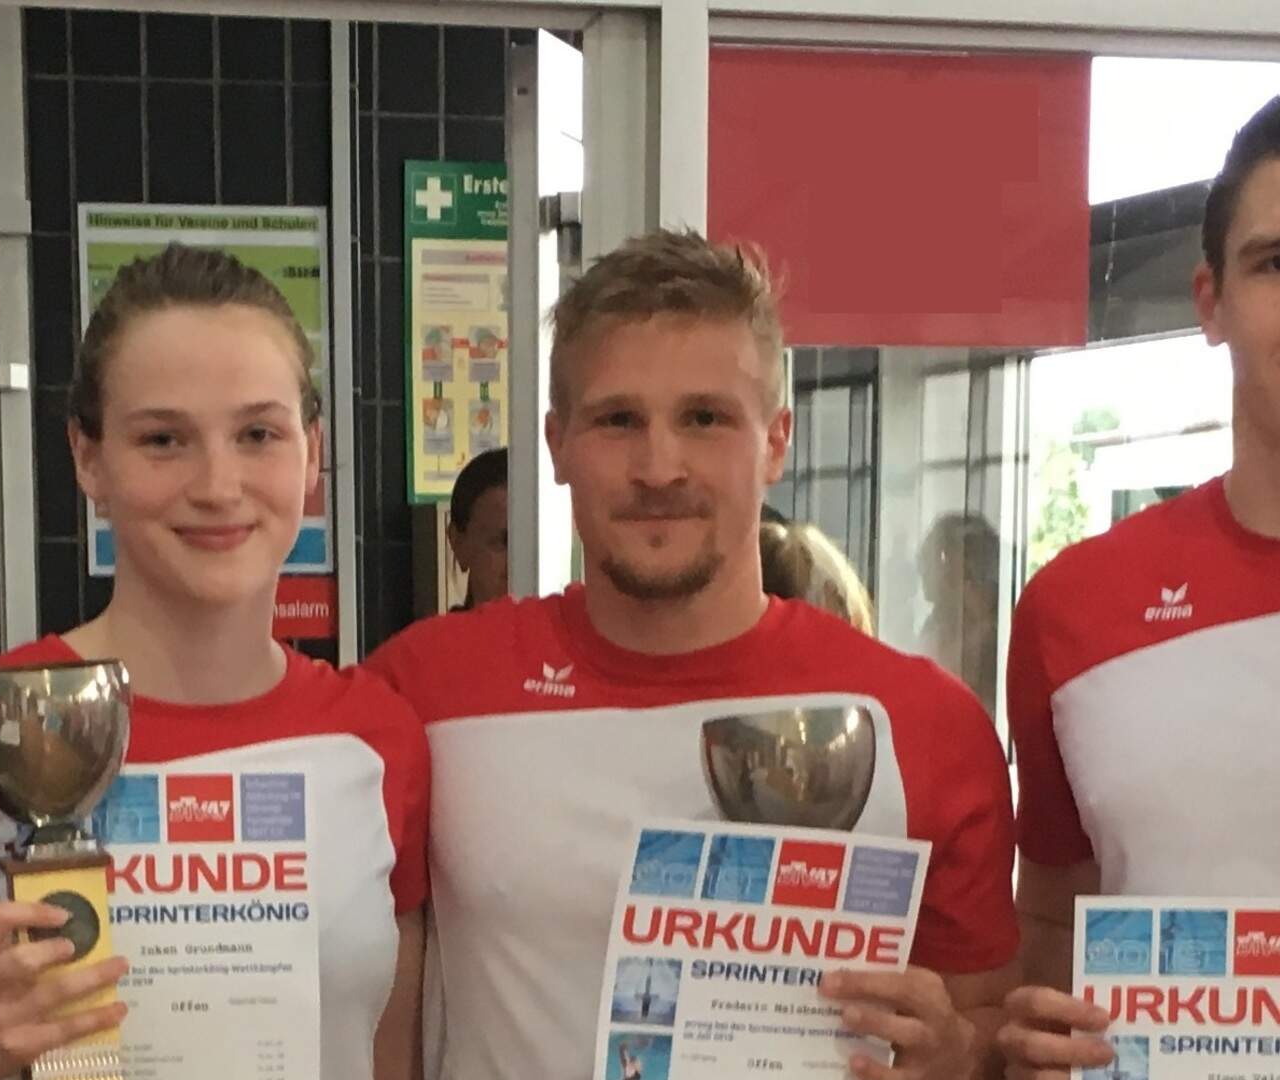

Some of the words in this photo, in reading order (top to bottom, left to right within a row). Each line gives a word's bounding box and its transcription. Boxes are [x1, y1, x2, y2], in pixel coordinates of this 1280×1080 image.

[104, 852, 308, 895] KUNDE
[622, 904, 906, 964] URKUNDE
[690, 959, 824, 988] SPRINTER
